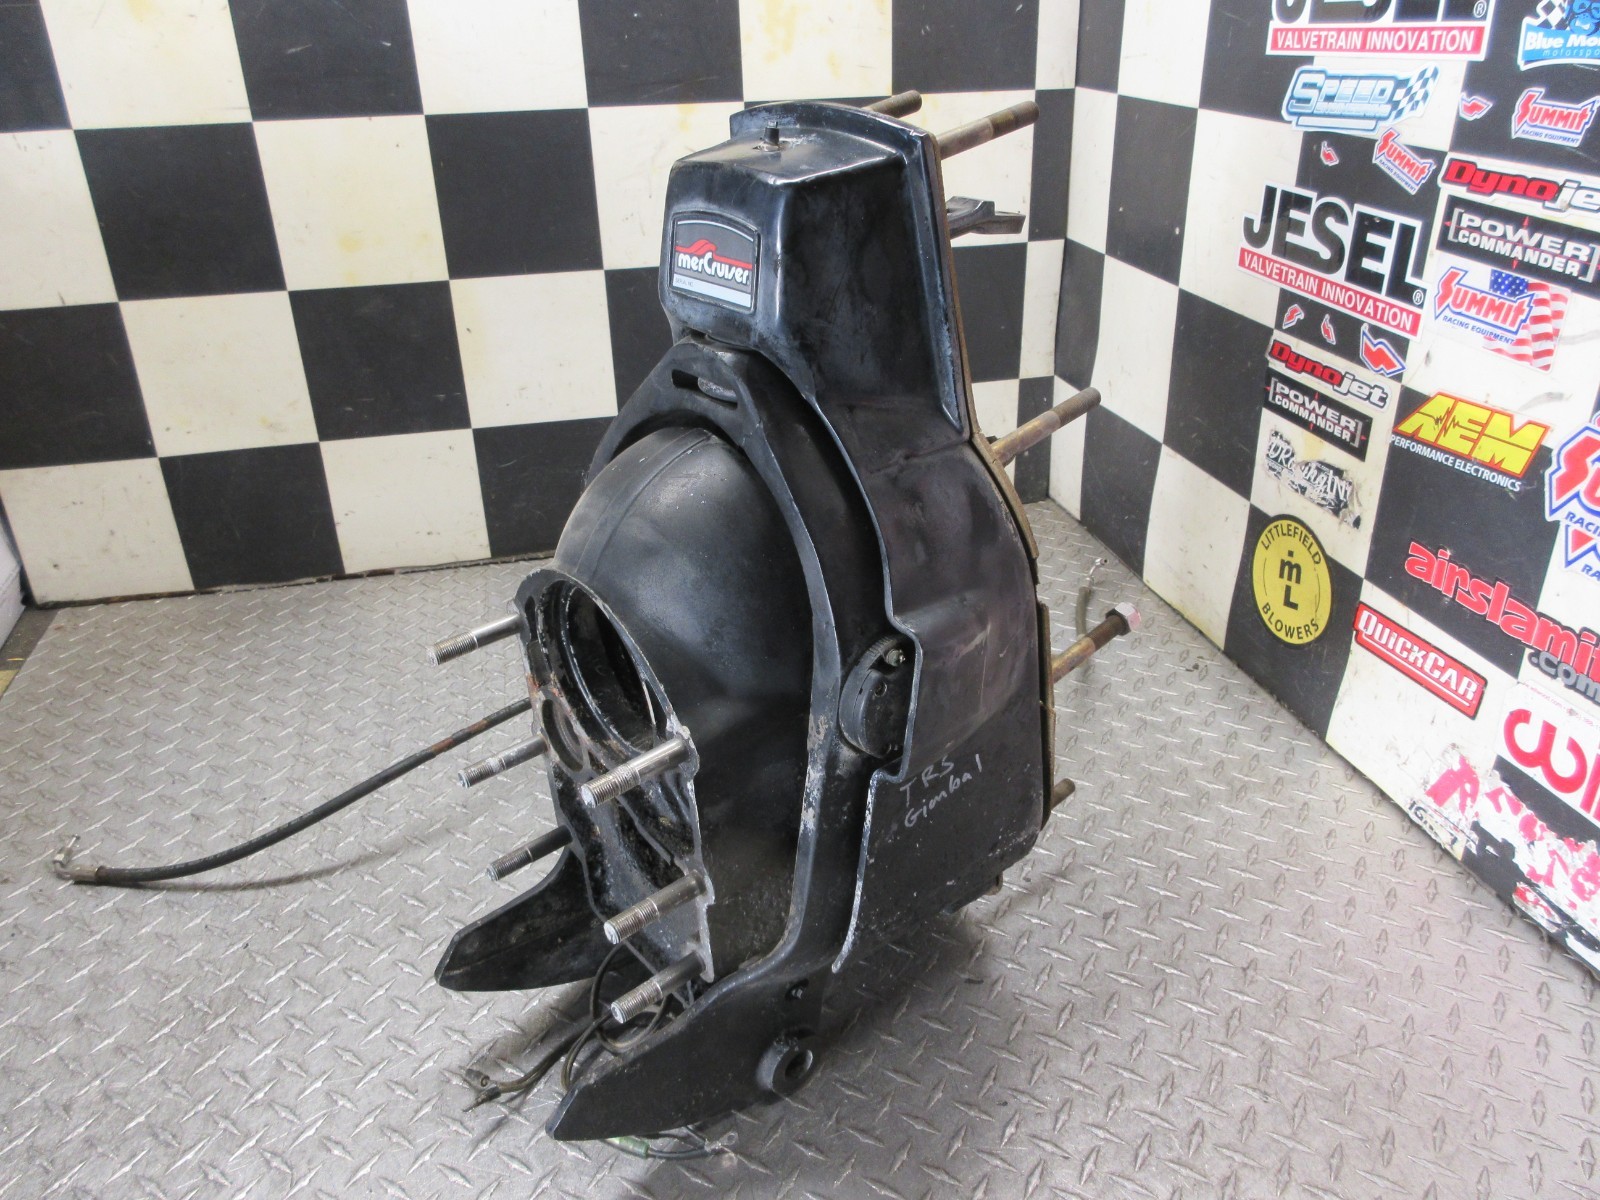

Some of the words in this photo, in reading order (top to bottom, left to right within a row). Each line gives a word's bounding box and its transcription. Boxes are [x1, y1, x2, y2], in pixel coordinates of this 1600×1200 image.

[1277, 31, 1363, 49] VALVETRAIN
[1366, 30, 1475, 51] INNOVATION
[1524, 31, 1563, 50] Blue
[1243, 184, 1427, 310] JESEL
[1458, 230, 1581, 277] COMMANDER
[1460, 213, 1592, 261] POWER
[1244, 251, 1318, 294] VALVETRAIN
[1321, 281, 1413, 331] INNOVATION
[1443, 315, 1470, 329] RACING
[1470, 325, 1515, 345] EQUIPMENT
[1269, 340, 1389, 408] Dynojet
[1275, 395, 1352, 442] COMMANDER
[1276, 382, 1357, 432] POWER
[1394, 393, 1548, 477] AEM
[1390, 434, 1455, 467] PERFORMANCE
[1454, 458, 1522, 492] ELECTRONICS
[1261, 523, 1321, 565] LITTLEFIELD
[1262, 602, 1319, 640] BLOWERS
[900, 755, 954, 807] TRS
